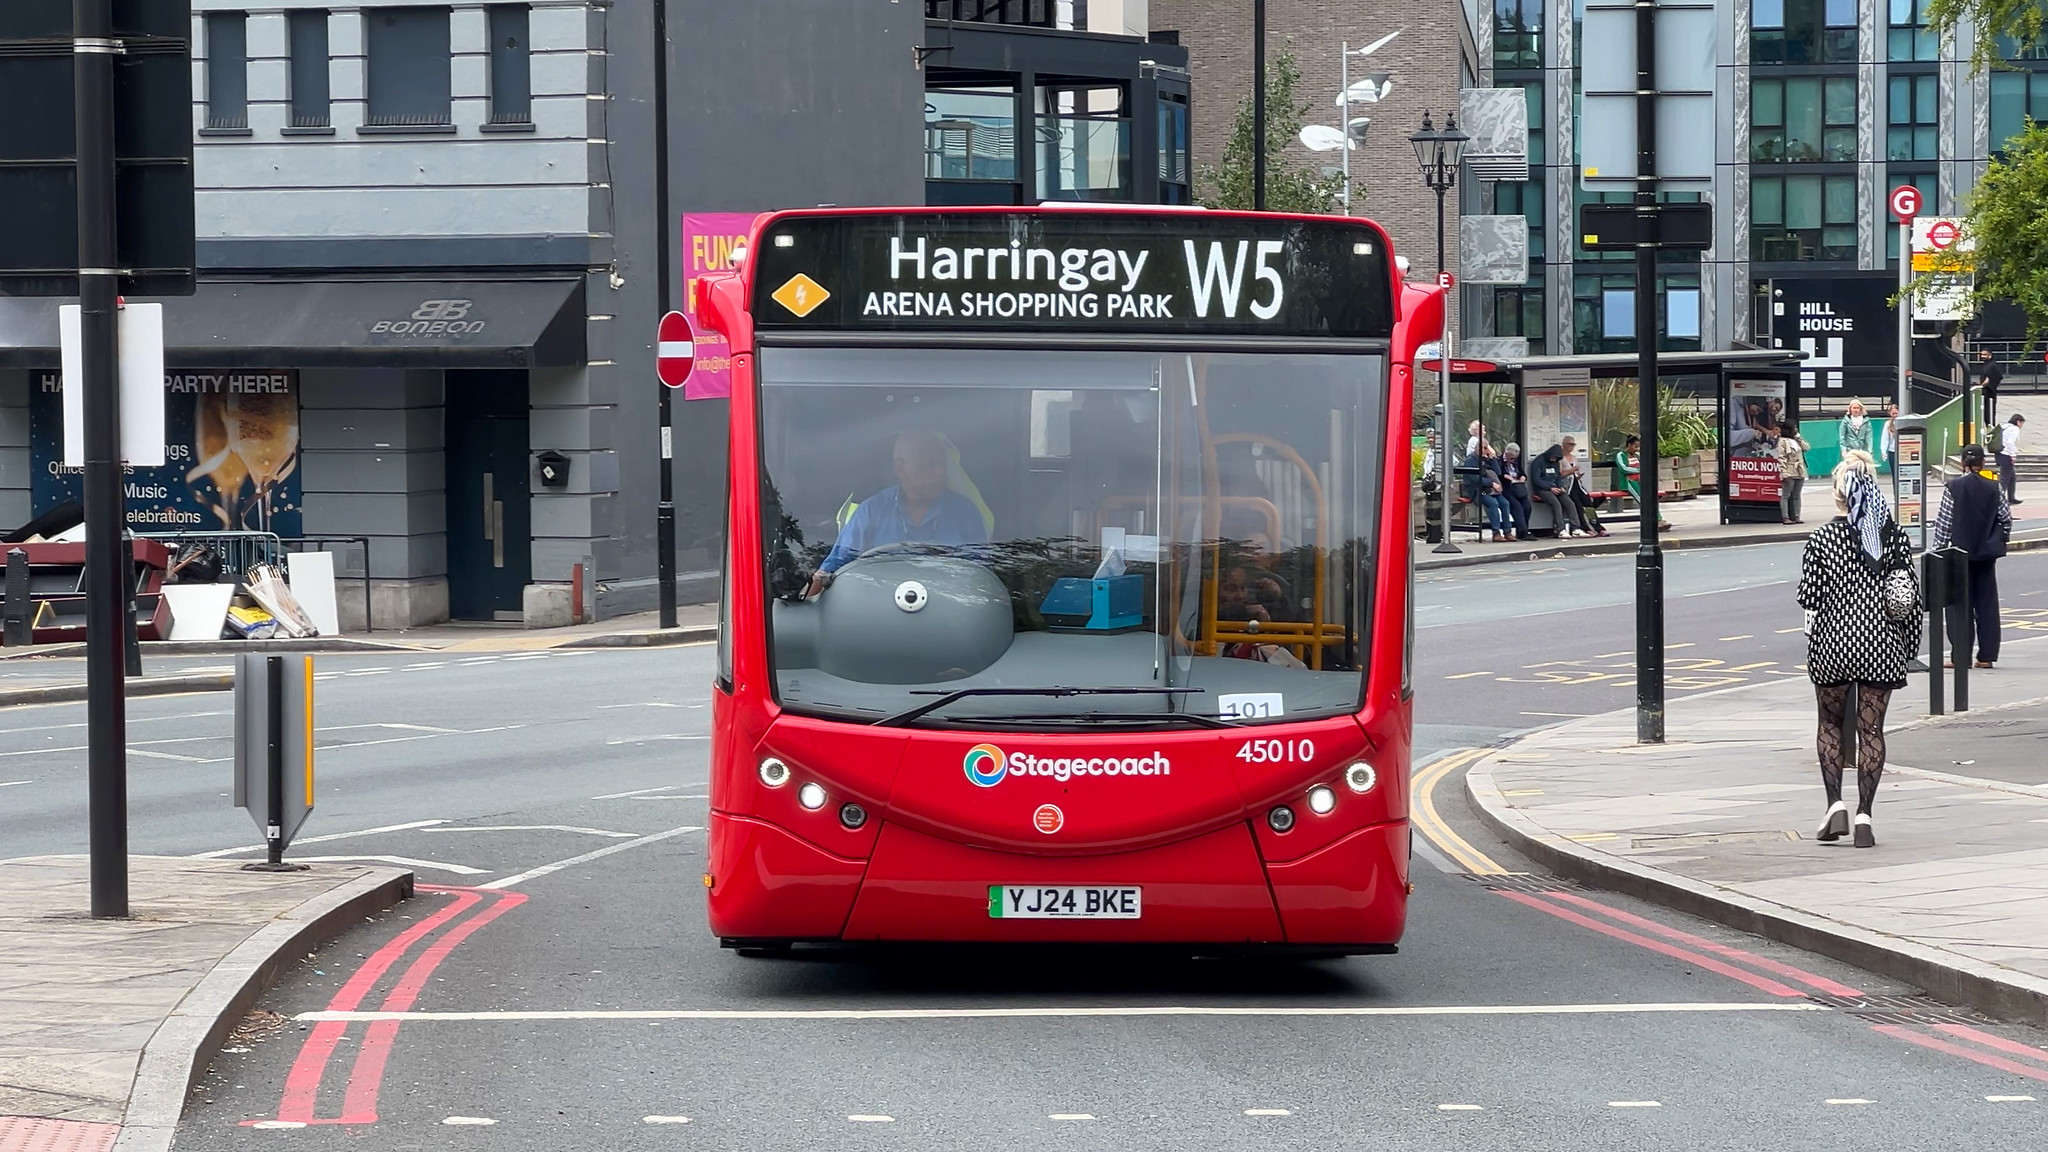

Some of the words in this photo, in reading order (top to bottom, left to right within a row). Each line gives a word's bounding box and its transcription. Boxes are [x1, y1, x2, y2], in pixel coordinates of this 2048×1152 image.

[1894, 191, 1915, 215] G
[891, 237, 1149, 292] Harringay
[1184, 239, 1285, 320] W5
[1439, 274, 1450, 288] E
[864, 293, 954, 316] ARENA
[961, 292, 1099, 318] SHOPPING
[1108, 293, 1174, 318] PARK
[1800, 303, 1835, 315] HILL
[1800, 318, 1854, 331] HOUSE
[164, 375, 224, 393] PARTY
[229, 375, 289, 393] HERE!
[1731, 460, 1759, 471] ENROL
[124, 483, 168, 499] Music
[126, 509, 201, 524] elebrations
[1227, 702, 1270, 719] 101
[1236, 739, 1314, 762] 45010
[1009, 751, 1170, 781] Stagecoach
[1009, 889, 1077, 912] YJ24
[1085, 889, 1136, 913] BKE
